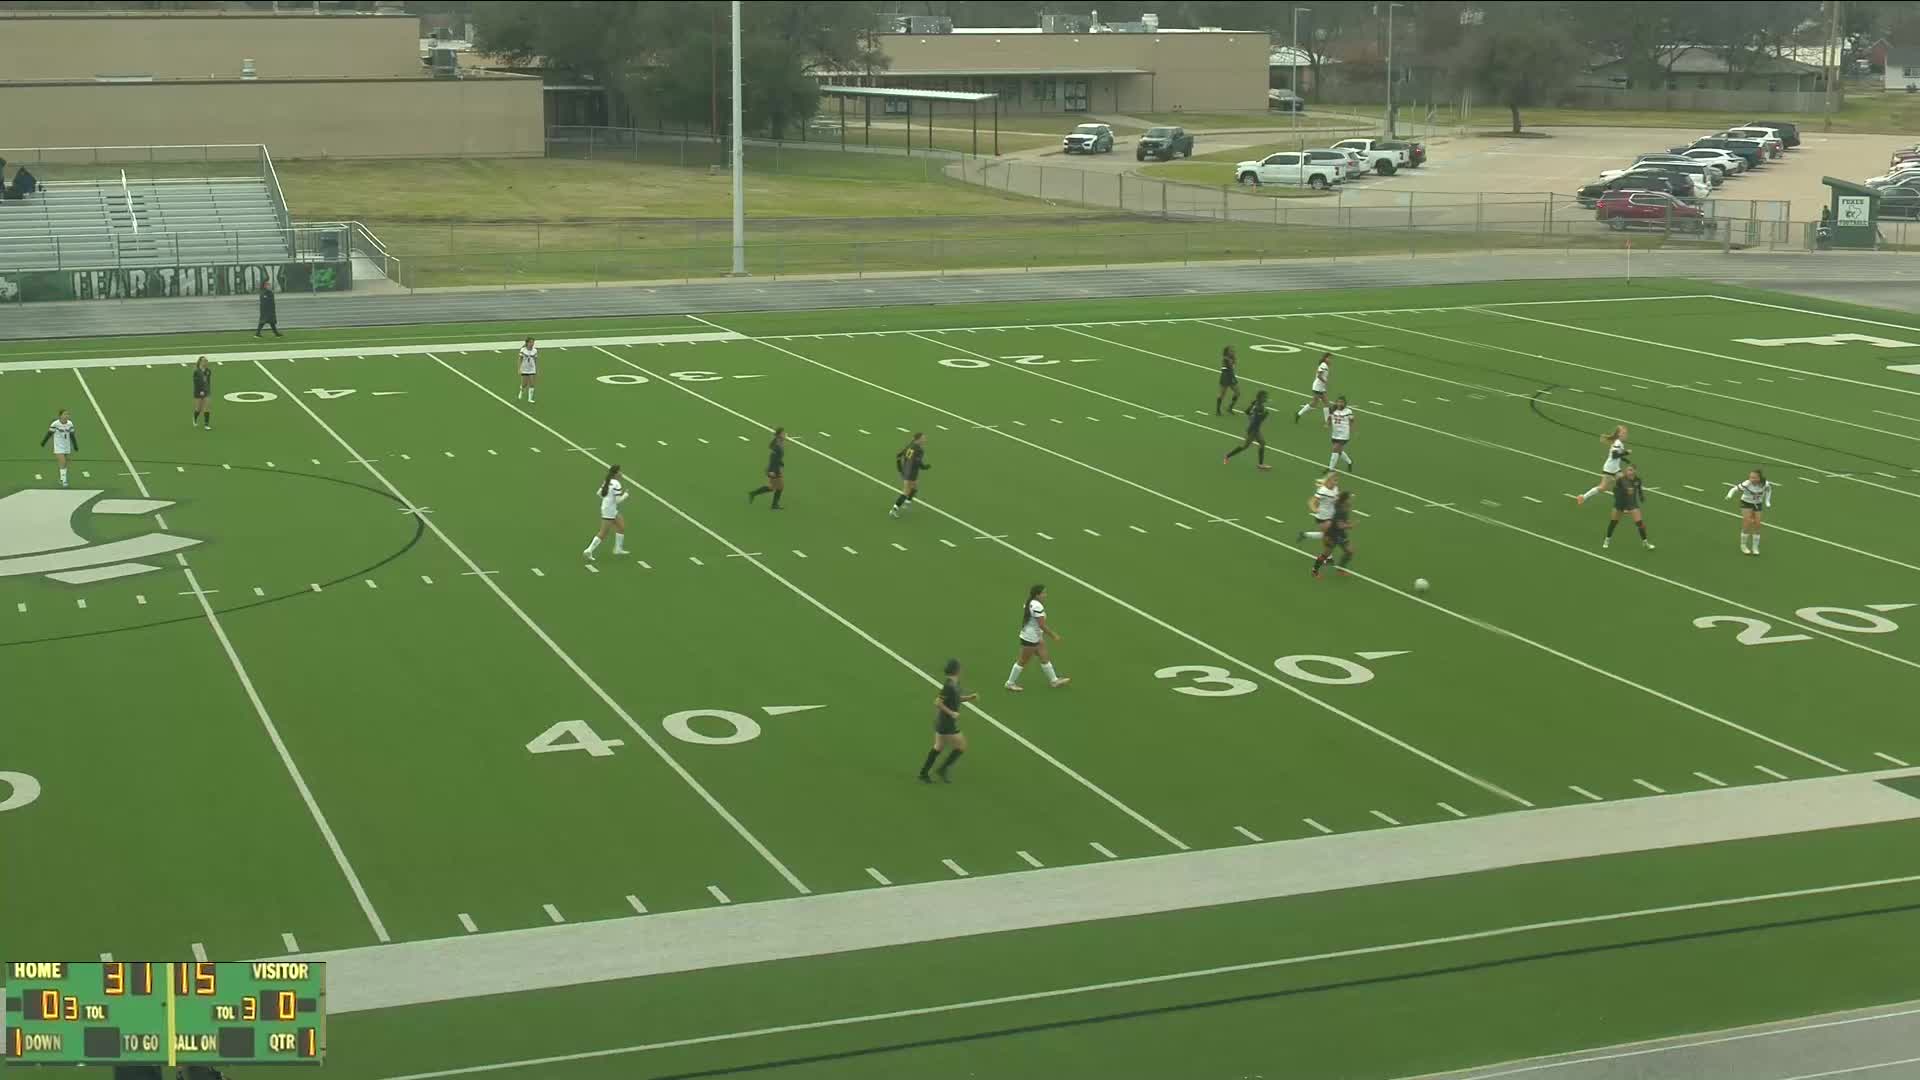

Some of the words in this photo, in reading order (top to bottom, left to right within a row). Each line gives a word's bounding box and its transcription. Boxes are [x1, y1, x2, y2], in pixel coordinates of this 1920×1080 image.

[73, 270, 146, 299] FEAR
[159, 268, 216, 297] THE
[228, 265, 284, 294] FOX
[1692, 606, 1899, 646] 20
[1154, 654, 1375, 697] 30
[525, 709, 761, 757] 40
